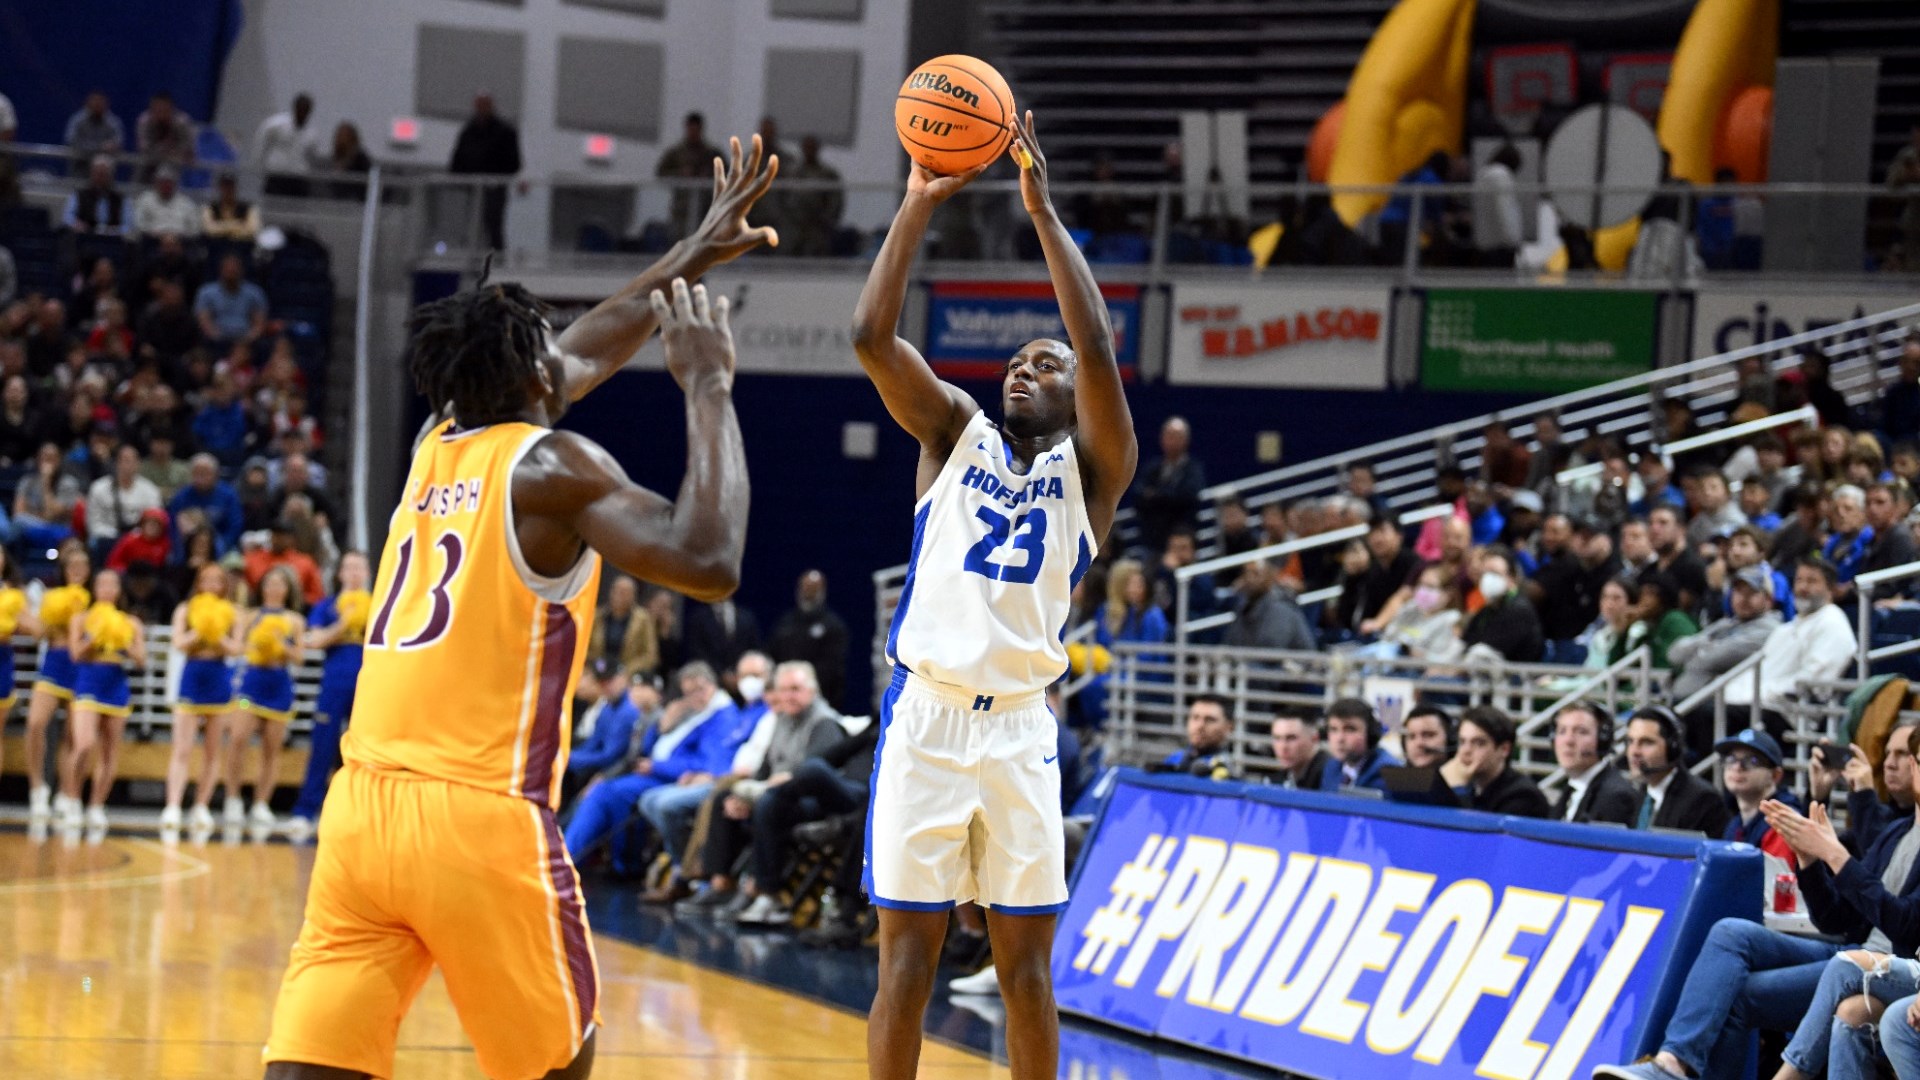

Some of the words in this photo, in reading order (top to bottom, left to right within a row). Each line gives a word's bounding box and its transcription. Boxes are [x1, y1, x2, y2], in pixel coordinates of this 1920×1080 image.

[908, 72, 979, 110] Wilson
[909, 114, 953, 137] EVO
[963, 504, 1047, 585] 23
[365, 530, 465, 650] 13
[972, 694, 995, 712] H
[1072, 832, 1666, 1080] #PRIDEOFLI
